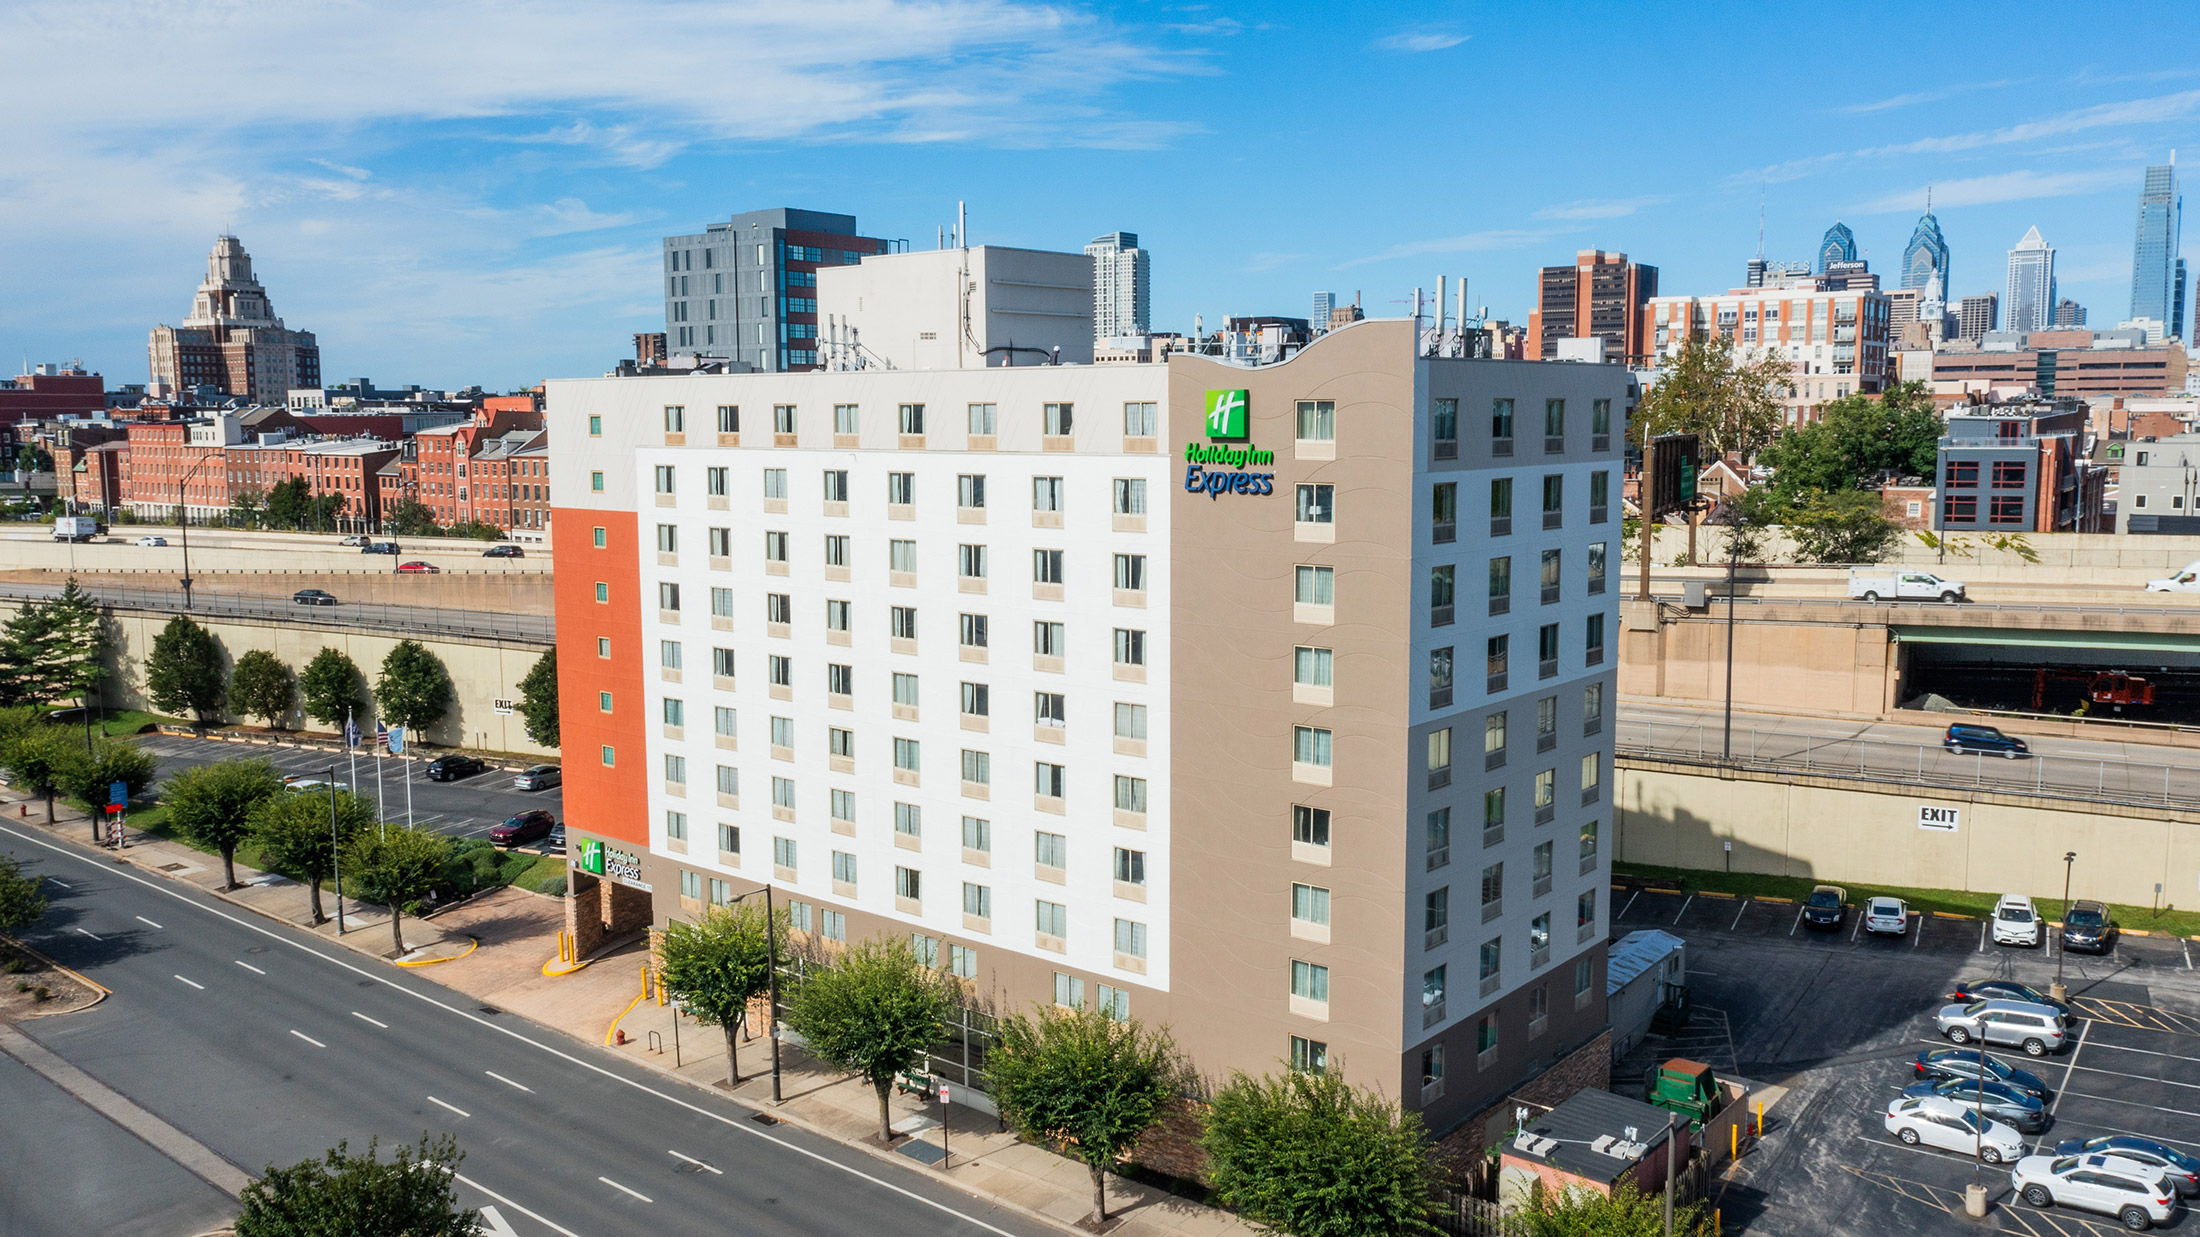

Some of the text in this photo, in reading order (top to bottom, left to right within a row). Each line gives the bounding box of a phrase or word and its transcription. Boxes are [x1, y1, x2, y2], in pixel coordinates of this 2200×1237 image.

[1829, 261, 1864, 270] Jefferson
[1184, 442, 1273, 467] Holiday Inn
[1184, 465, 1273, 498] Express
[495, 699, 512, 709] EXIT
[1921, 807, 1957, 823] EXIT
[605, 846, 639, 865] Holiday Inn
[606, 858, 639, 880] Express
[623, 878, 646, 889] CLEARANCE
